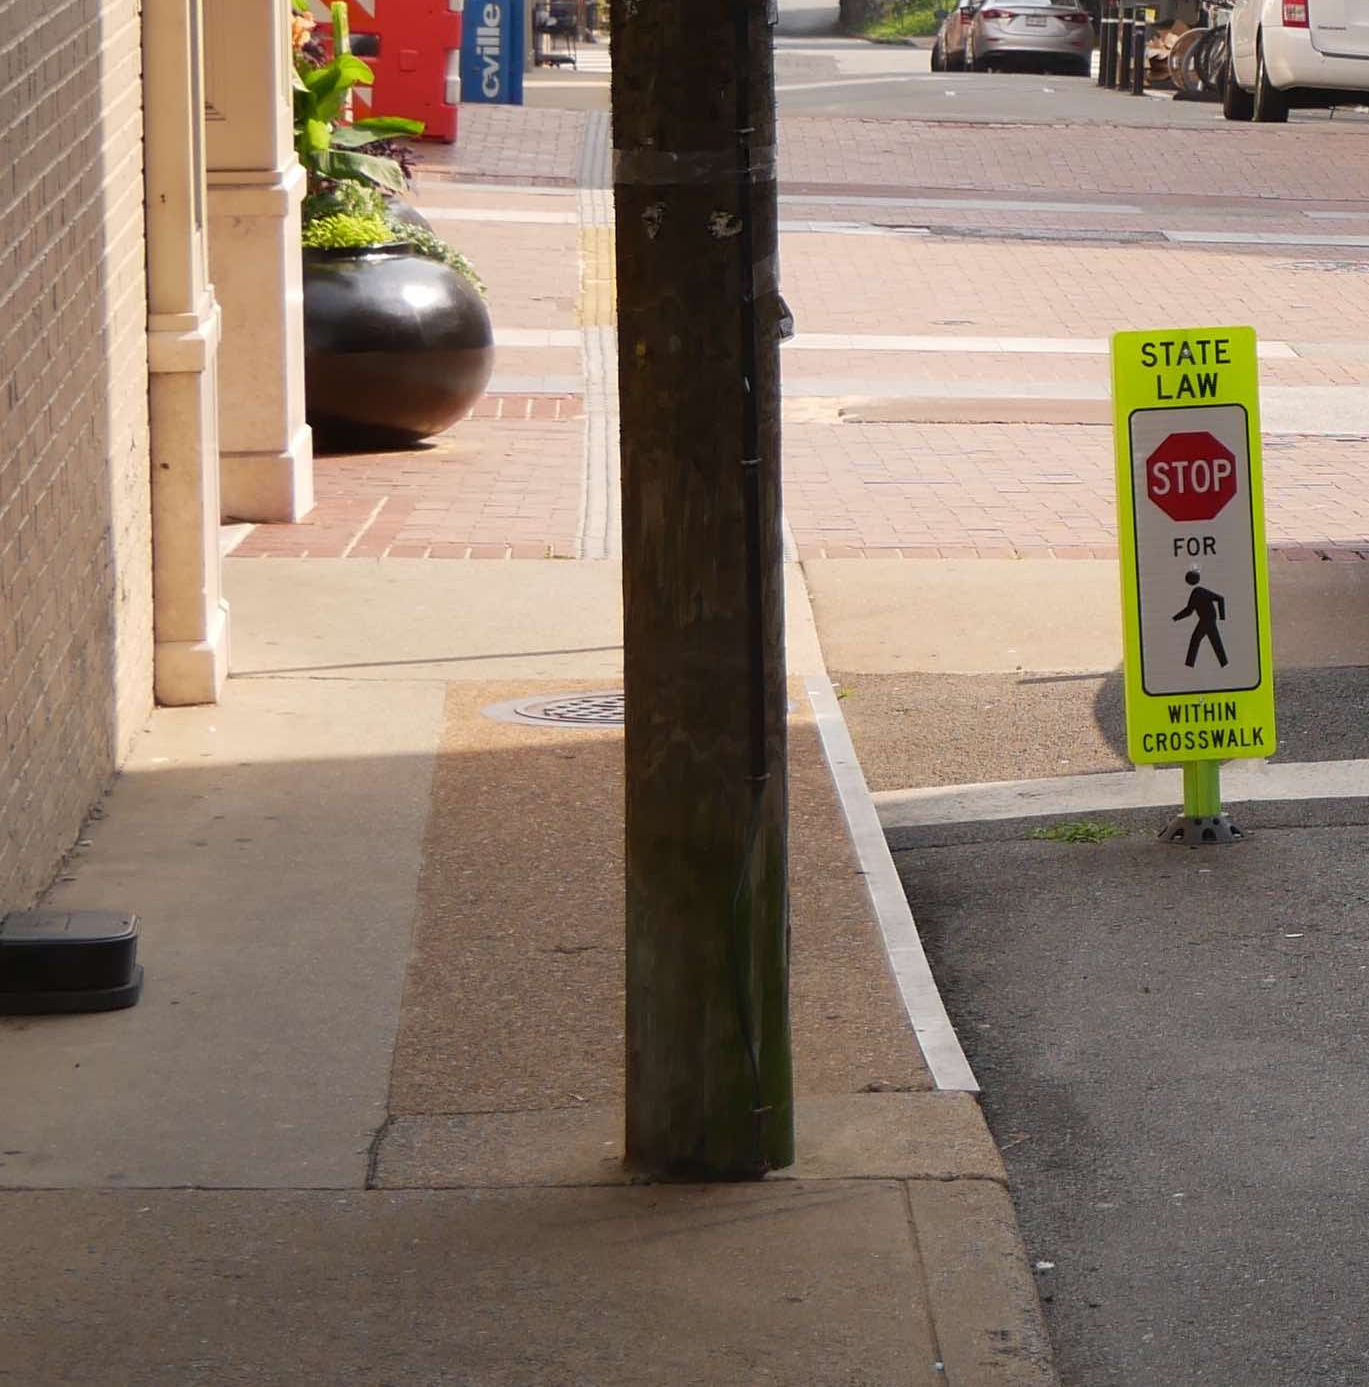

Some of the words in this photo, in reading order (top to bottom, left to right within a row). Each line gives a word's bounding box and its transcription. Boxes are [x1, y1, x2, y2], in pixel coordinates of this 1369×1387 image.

[475, 3, 501, 98] cville
[1141, 339, 1231, 367] STATE
[1156, 373, 1218, 400] LAW
[1152, 459, 1233, 494] STOP
[1173, 536, 1217, 558] FOR
[1168, 701, 1237, 724] WITHIN
[1143, 726, 1264, 754] CROSSWALK
